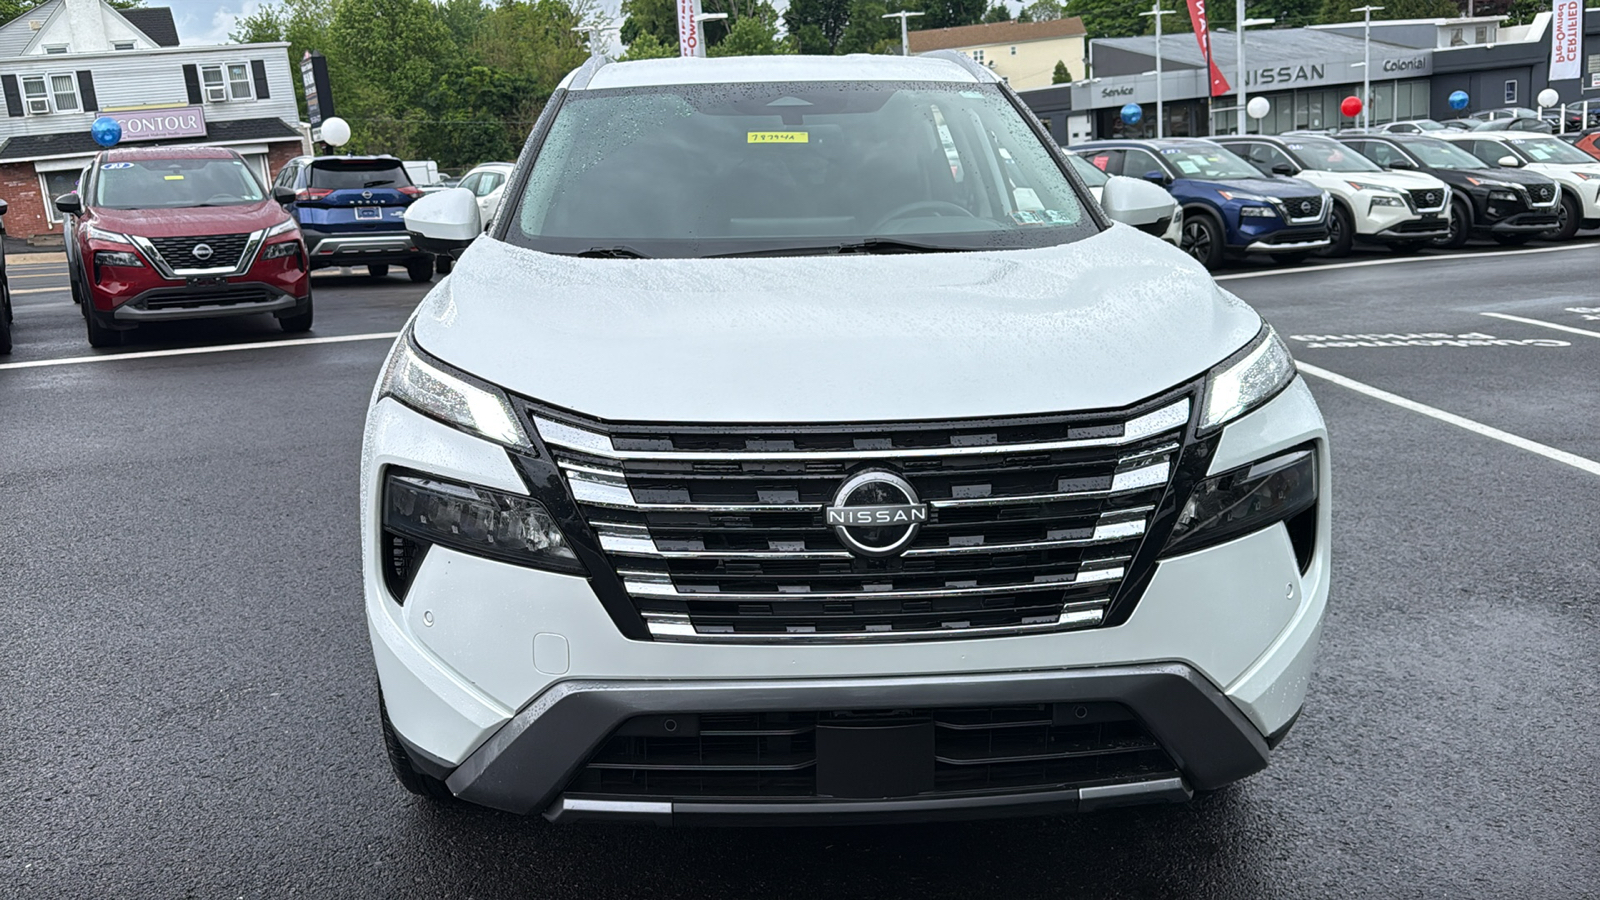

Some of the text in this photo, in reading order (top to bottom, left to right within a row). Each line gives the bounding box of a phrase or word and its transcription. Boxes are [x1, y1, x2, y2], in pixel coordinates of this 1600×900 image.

[1383, 57, 1426, 72] Colonial
[1101, 86, 1134, 98] Service
[829, 507, 926, 523] NISSAN
